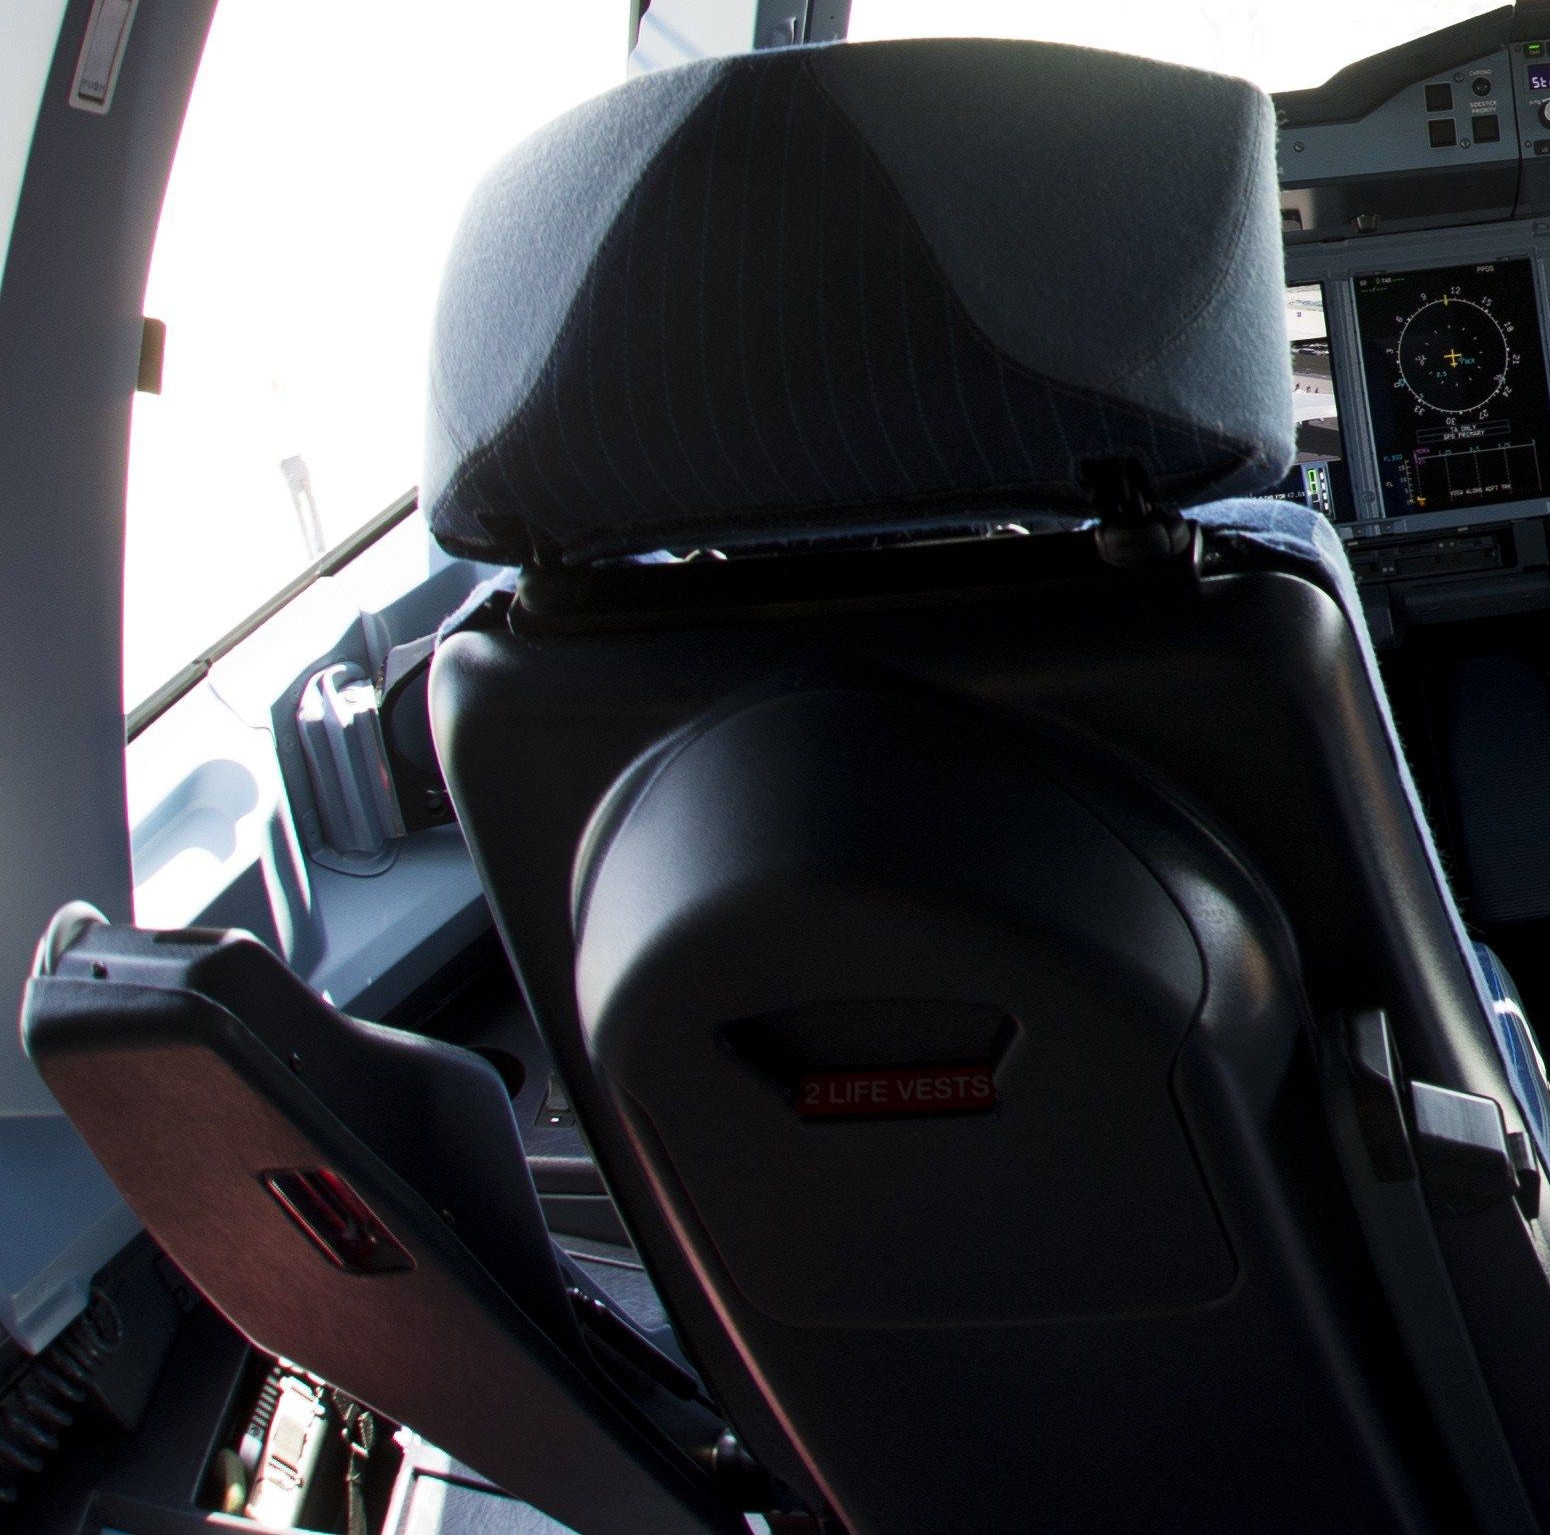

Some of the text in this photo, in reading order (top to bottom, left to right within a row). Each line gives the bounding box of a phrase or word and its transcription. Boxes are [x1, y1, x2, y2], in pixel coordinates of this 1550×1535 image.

[1450, 286, 1461, 295] 12
[1481, 296, 1493, 306] 15
[1457, 428, 1485, 439] PRIMARY
[804, 1074, 990, 1105] 2 LIFE VESTS
